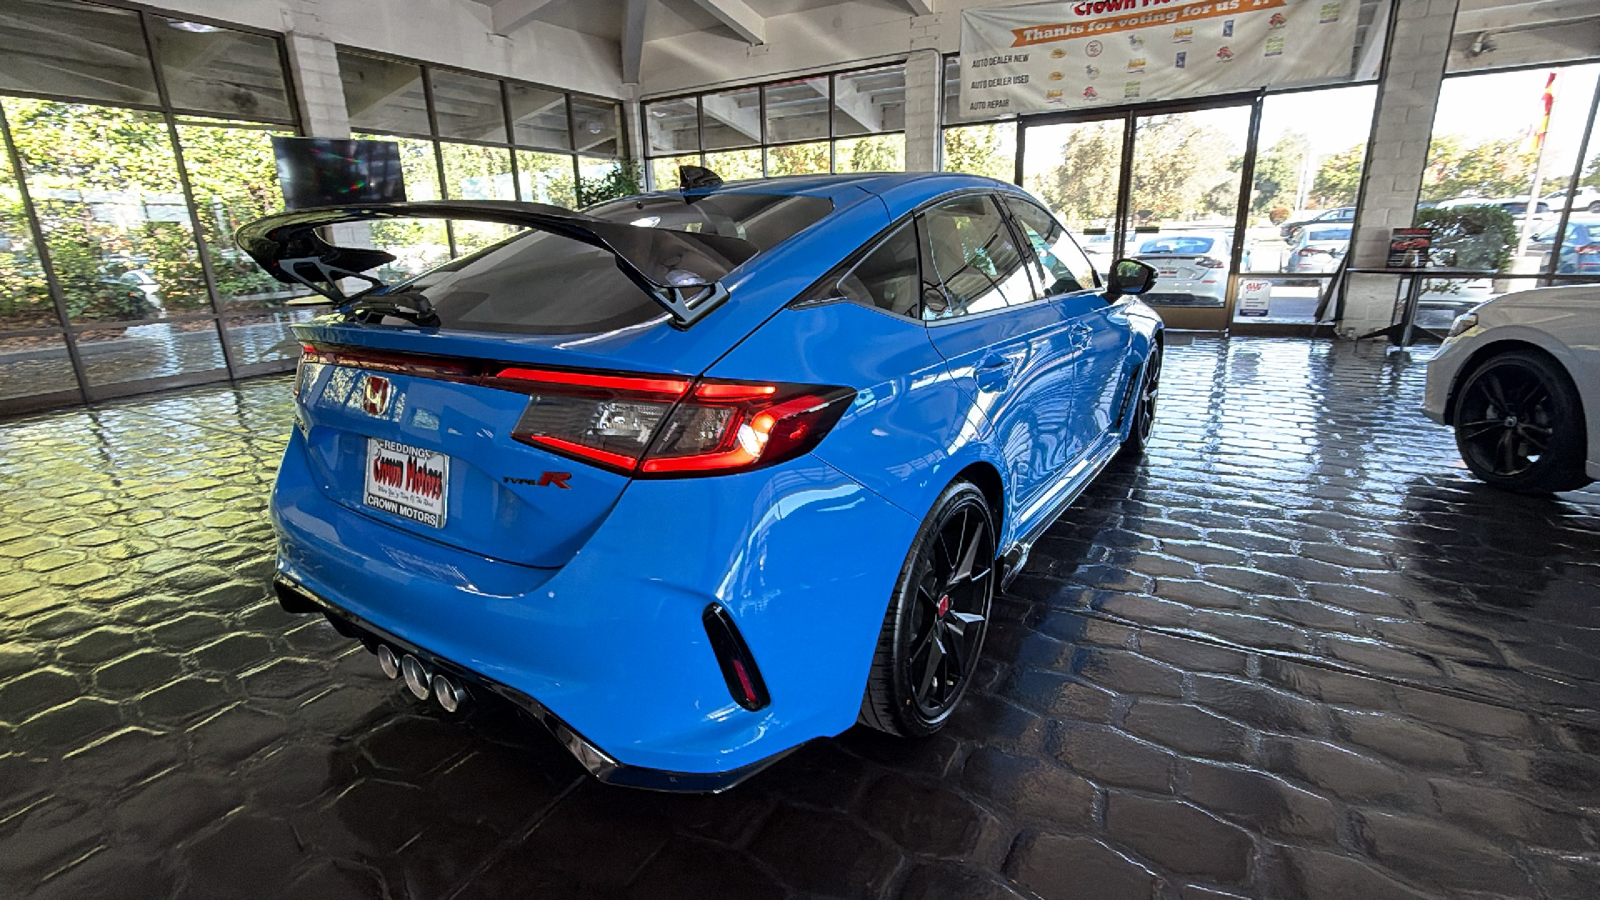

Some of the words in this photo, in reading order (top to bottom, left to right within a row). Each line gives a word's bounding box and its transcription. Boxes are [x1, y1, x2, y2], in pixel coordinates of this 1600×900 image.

[1023, 21, 1084, 41] Thanks
[1087, 20, 1115, 32] for
[1119, 10, 1176, 28] voting
[1182, 4, 1213, 17] for
[1216, 0, 1240, 11] us
[972, 57, 988, 68] AUTO
[988, 54, 1012, 67] DEALER
[1013, 53, 1029, 63] NEW
[971, 79, 987, 89] AUTO
[988, 76, 1012, 88] DEALER
[1012, 74, 1029, 84] USED
[970, 101, 986, 110] AUTO
[987, 98, 1010, 109] REPAIR
[373, 456, 404, 489] Crown
[405, 455, 443, 501] Motors
[538, 471, 573, 490] R
[368, 495, 398, 513] CROWN
[400, 504, 436, 526] MOTORS
